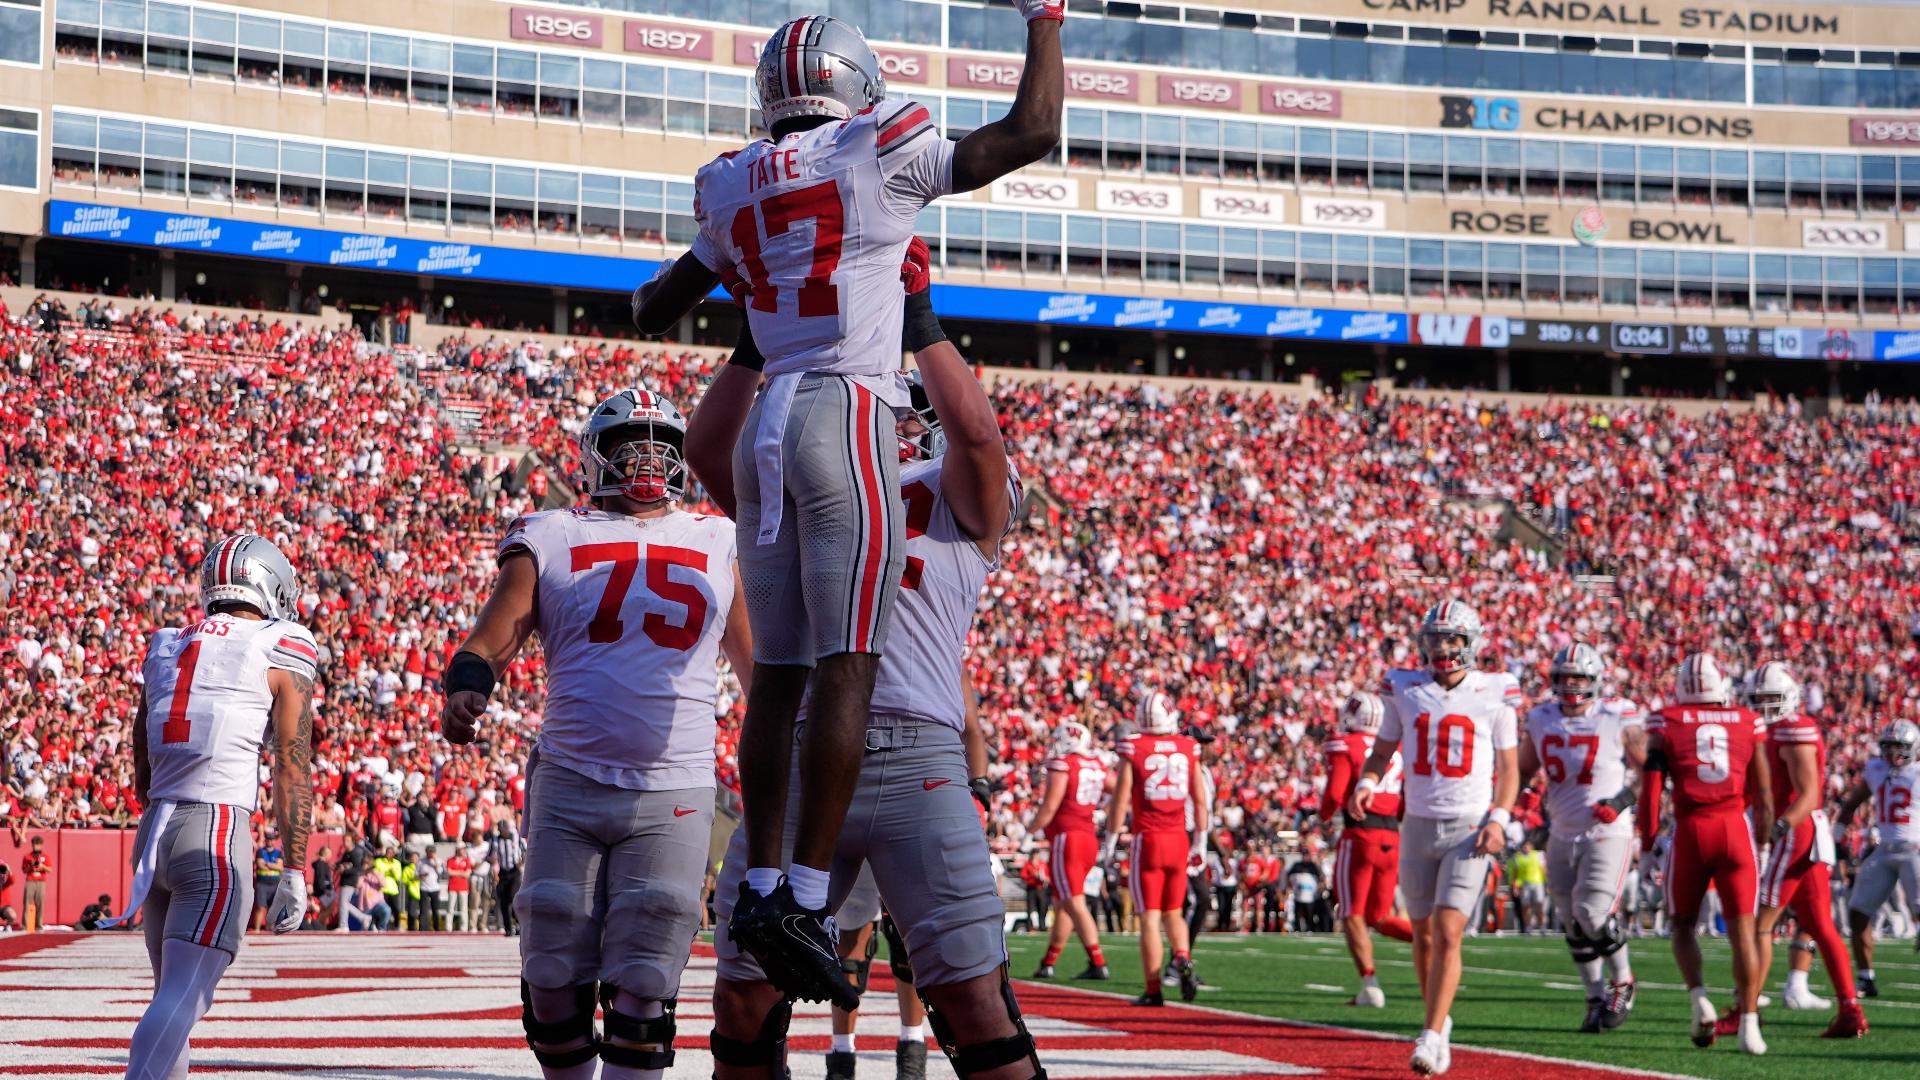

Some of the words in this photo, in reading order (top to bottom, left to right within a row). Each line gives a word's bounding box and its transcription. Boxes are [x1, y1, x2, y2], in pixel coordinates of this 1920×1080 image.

[524, 14, 592, 39] 1896
[1489, 0, 1661, 26] RANDALL
[1680, 8, 1839, 35] STADIUM
[638, 27, 702, 51] 1897
[966, 63, 1019, 85] 1912
[1068, 71, 1130, 94] 1952
[1171, 80, 1232, 103] 1959
[1272, 88, 1334, 112] 1962
[771, 99, 824, 112] BUCKEYES
[1535, 107, 1754, 138] CHAMPIONS
[747, 149, 800, 193] TATE
[1003, 181, 1067, 201] 1960
[1110, 190, 1170, 208] 1963
[74, 207, 119, 221] Siding
[1214, 197, 1272, 216] 1994
[1313, 203, 1375, 223] 1999
[62, 216, 131, 235] Unlimited
[166, 217, 210, 231] Siding
[1450, 210, 1550, 235] ROSE
[1628, 220, 1735, 244] BOWL
[154, 227, 221, 245] Unlimited
[252, 237, 301, 251] Unlimited
[261, 230, 293, 242] Siding
[342, 237, 386, 250] Siding
[1807, 227, 1880, 243] 2000
[330, 245, 398, 265] Unlimited
[429, 245, 471, 259] Siding
[731, 179, 844, 317] 17
[417, 254, 482, 272] Unlimited
[1489, 326, 1500, 339] 0
[1538, 323, 1573, 341] 3RD
[1586, 325, 1599, 343] 4
[1619, 326, 1665, 347] 0:04
[1686, 326, 1708, 344] 10
[1723, 327, 1750, 343] 1ST
[1779, 335, 1797, 349] 10
[570, 541, 709, 651] 75
[162, 640, 203, 744] 1
[1413, 712, 1476, 778] 10
[1696, 723, 1730, 785] 9
[1541, 735, 1600, 785] 67
[1144, 753, 1190, 801] 29
[1877, 784, 1912, 825] 12
